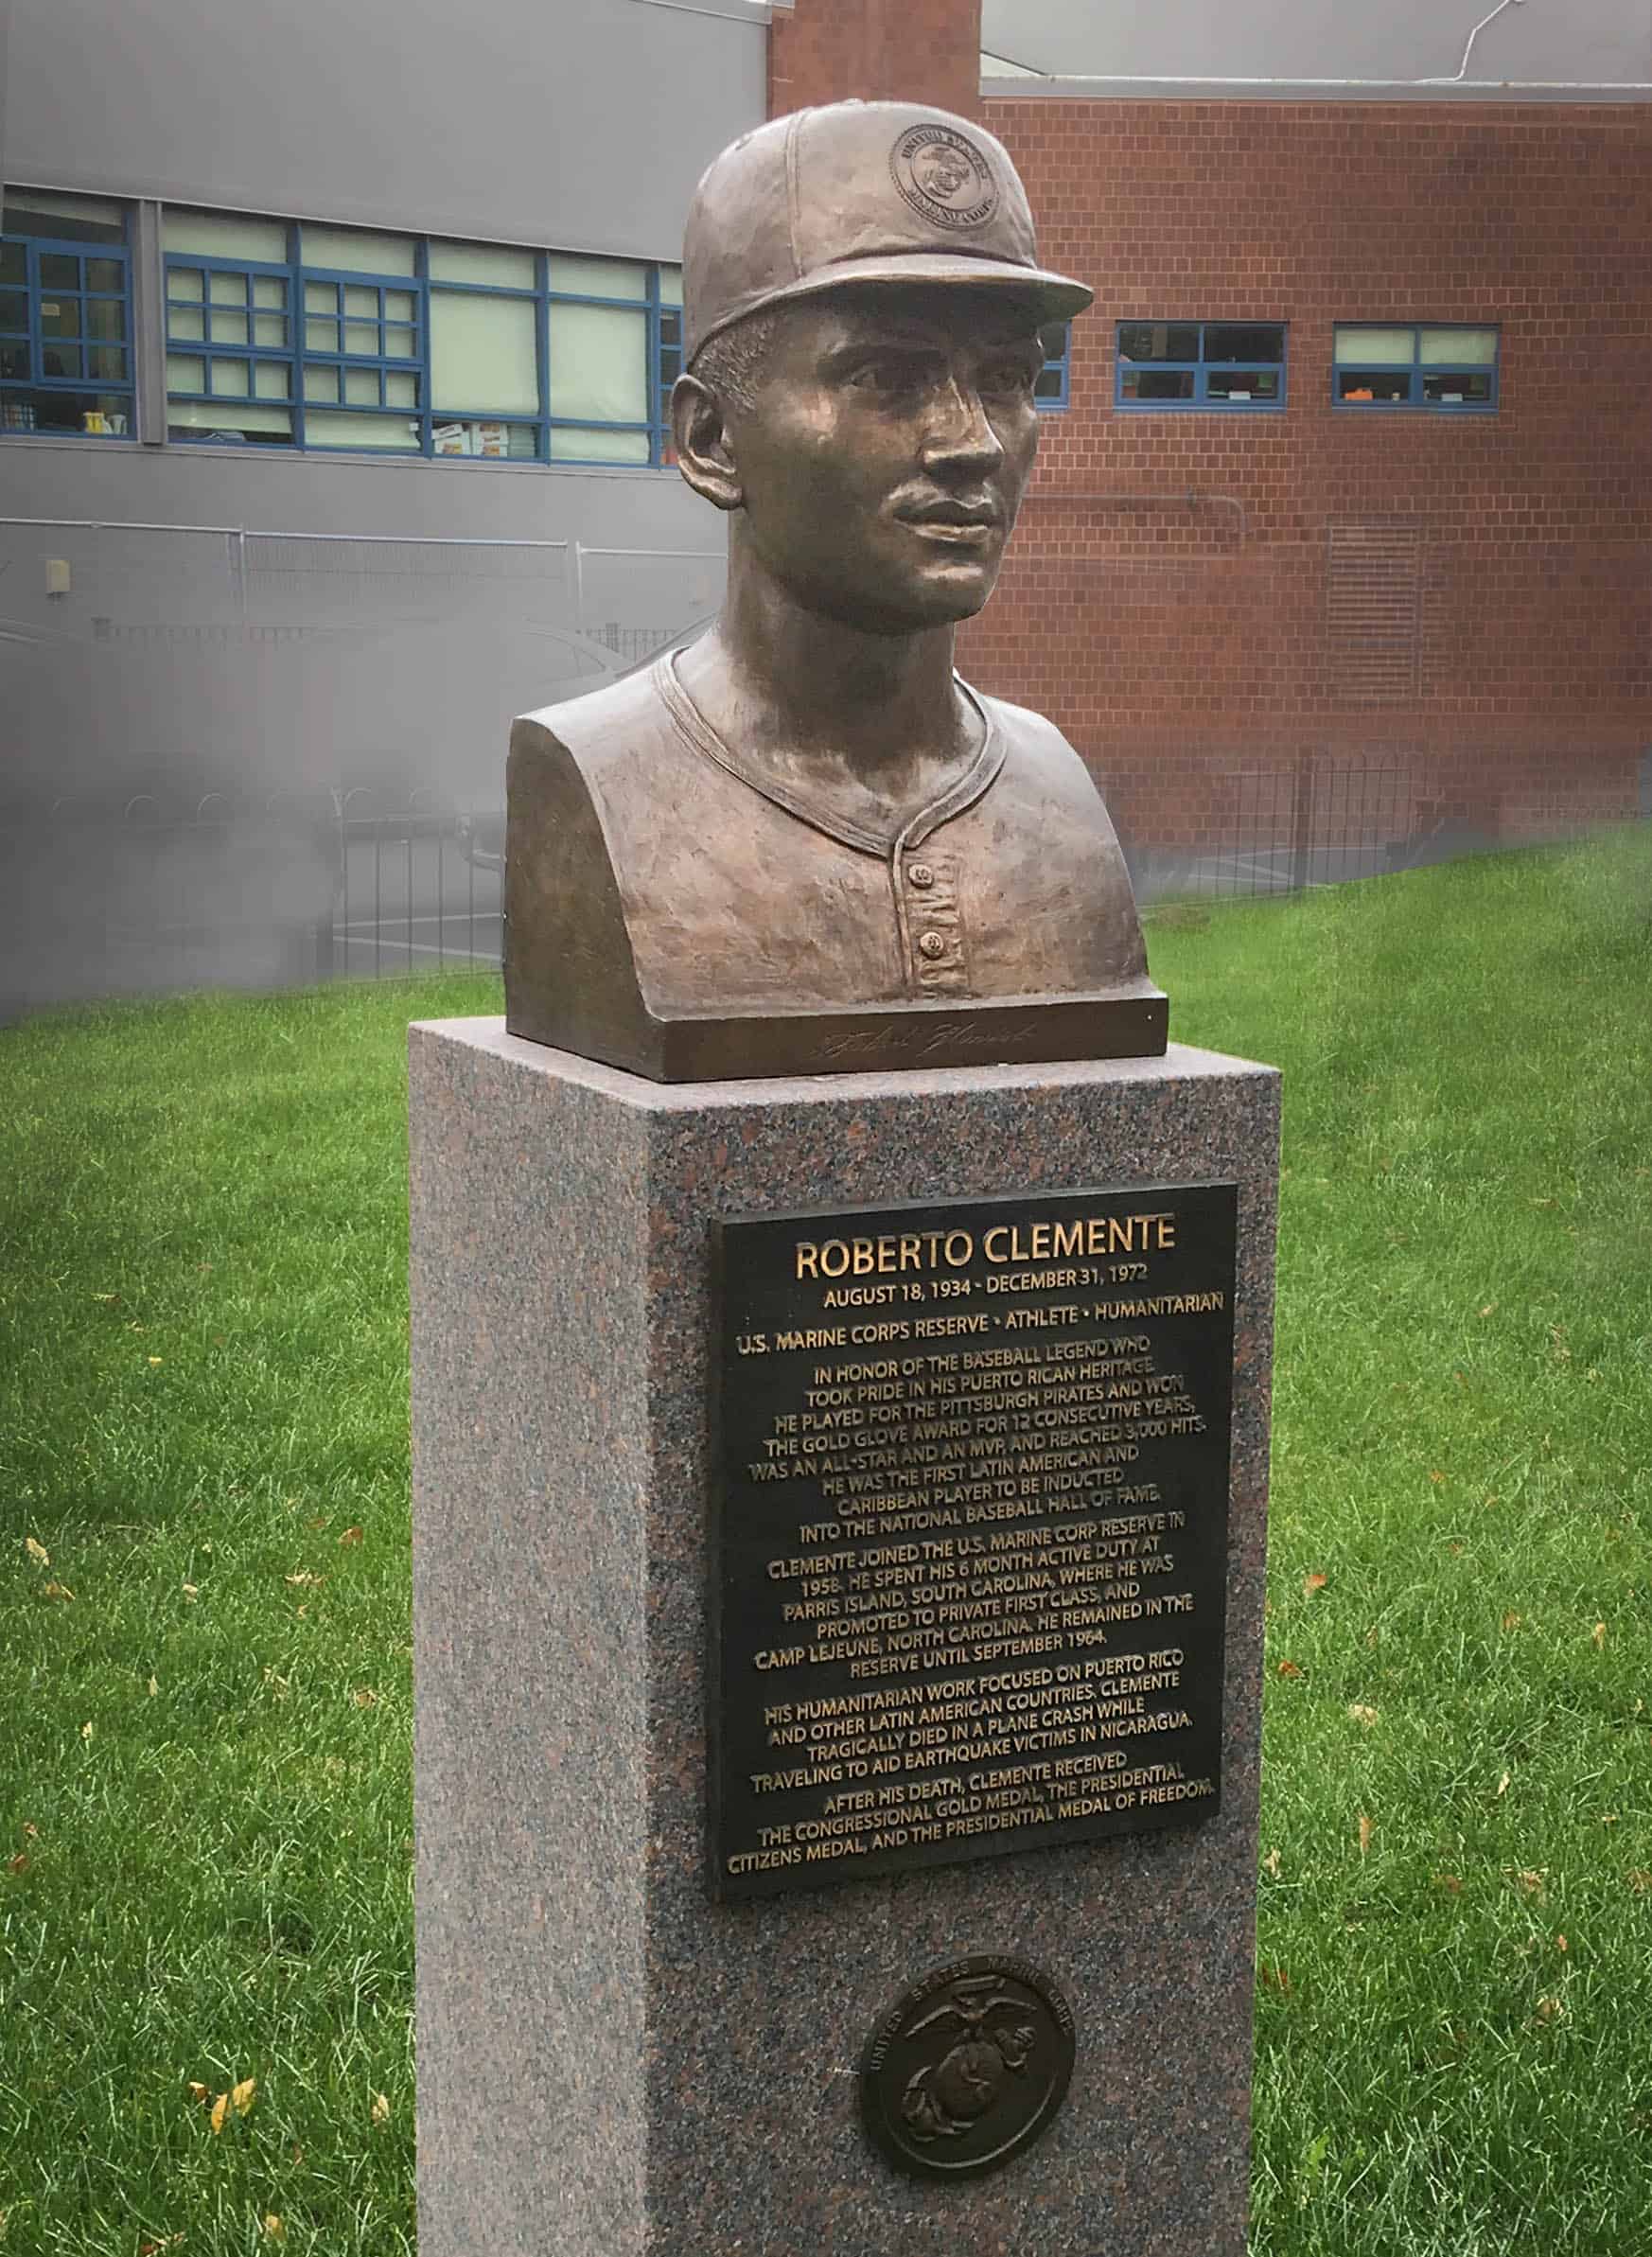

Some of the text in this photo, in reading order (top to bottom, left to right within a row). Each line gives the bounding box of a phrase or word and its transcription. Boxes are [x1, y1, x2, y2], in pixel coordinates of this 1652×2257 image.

[795, 1213, 1175, 1278] ROBERTO CLEMENTE
[822, 1262, 1147, 1308] AUGUST 18, 1934 DECEMBER 31, 1972
[735, 1292, 1223, 1354] U.S. MARINE CORPS RESERVE ATHLETE HUMANITARIAN
[804, 1365, 1076, 1407] TOOK PRIDE IN HIS PUERTO RICAN
[814, 1334, 1151, 1384] IN HONOR OF THE BASEBALL LEGEND WHO
[764, 1400, 1141, 1456] THE GOLD AWARD FOR CONSECUTIVE
[774, 1379, 1142, 1434] HE PLAYED FOR THE PITTSBURGH PIRATES AND
[748, 1419, 1167, 1479] WAS AN AND AN AND REACHED 3,000
[822, 1444, 1138, 1495] HE WAS THE FIRST LATIN AMERICAN AND
[800, 1492, 1087, 1543] INTO THE NATIONAL BASEBALL HALL
[837, 1466, 1123, 1515] CARIBBEAN PLAYER TO BE INDUCTED
[767, 1512, 1165, 1578] CLEMENTE JOINED THE U.S. MARINE CORP RESERVE
[849, 1536, 1160, 1590] HE SPENT HIS 6 MONTH ACTIVE DUTY AT
[783, 1554, 1173, 1620] PARRIS ISLAND, SOUTH CAROLINA, WHERE HE WAS
[817, 1581, 1139, 1639] PROMOTED TO PRIVATE FIRST CLASS, AND
[753, 1593, 1193, 1669] CAMP LEJEUNE, NORTH CAROLINA. HE REMAINED IN THE
[850, 1628, 1107, 1678] RESERVE UNTIL SEPTEMBER 1964.
[764, 1649, 1184, 1725] HIS HUMANITARIAN WORK FOCUSED ON PUERTO RICO
[769, 1669, 1179, 1745] AND OTHER LATIN AMERICAN COUNTRIES. CLEMENTE
[749, 1710, 1192, 1792] TRAVELING TO AID EARTHQUAKE VICTIMS IN NICARAGUA.
[806, 1696, 1144, 1762] TRAGICALLY DIED IN A PLANE CRASH WHILE
[757, 1779, 1077, 1846] THE CONGRESSIONAL GOLD THE
[824, 1751, 1127, 1814] AFTER HIS DEATH, CLEMENTE RECEIVED
[728, 1791, 1135, 1873] CITIZENS MEDAL, AND THE PRESIDENTIAL MEDAL OF
